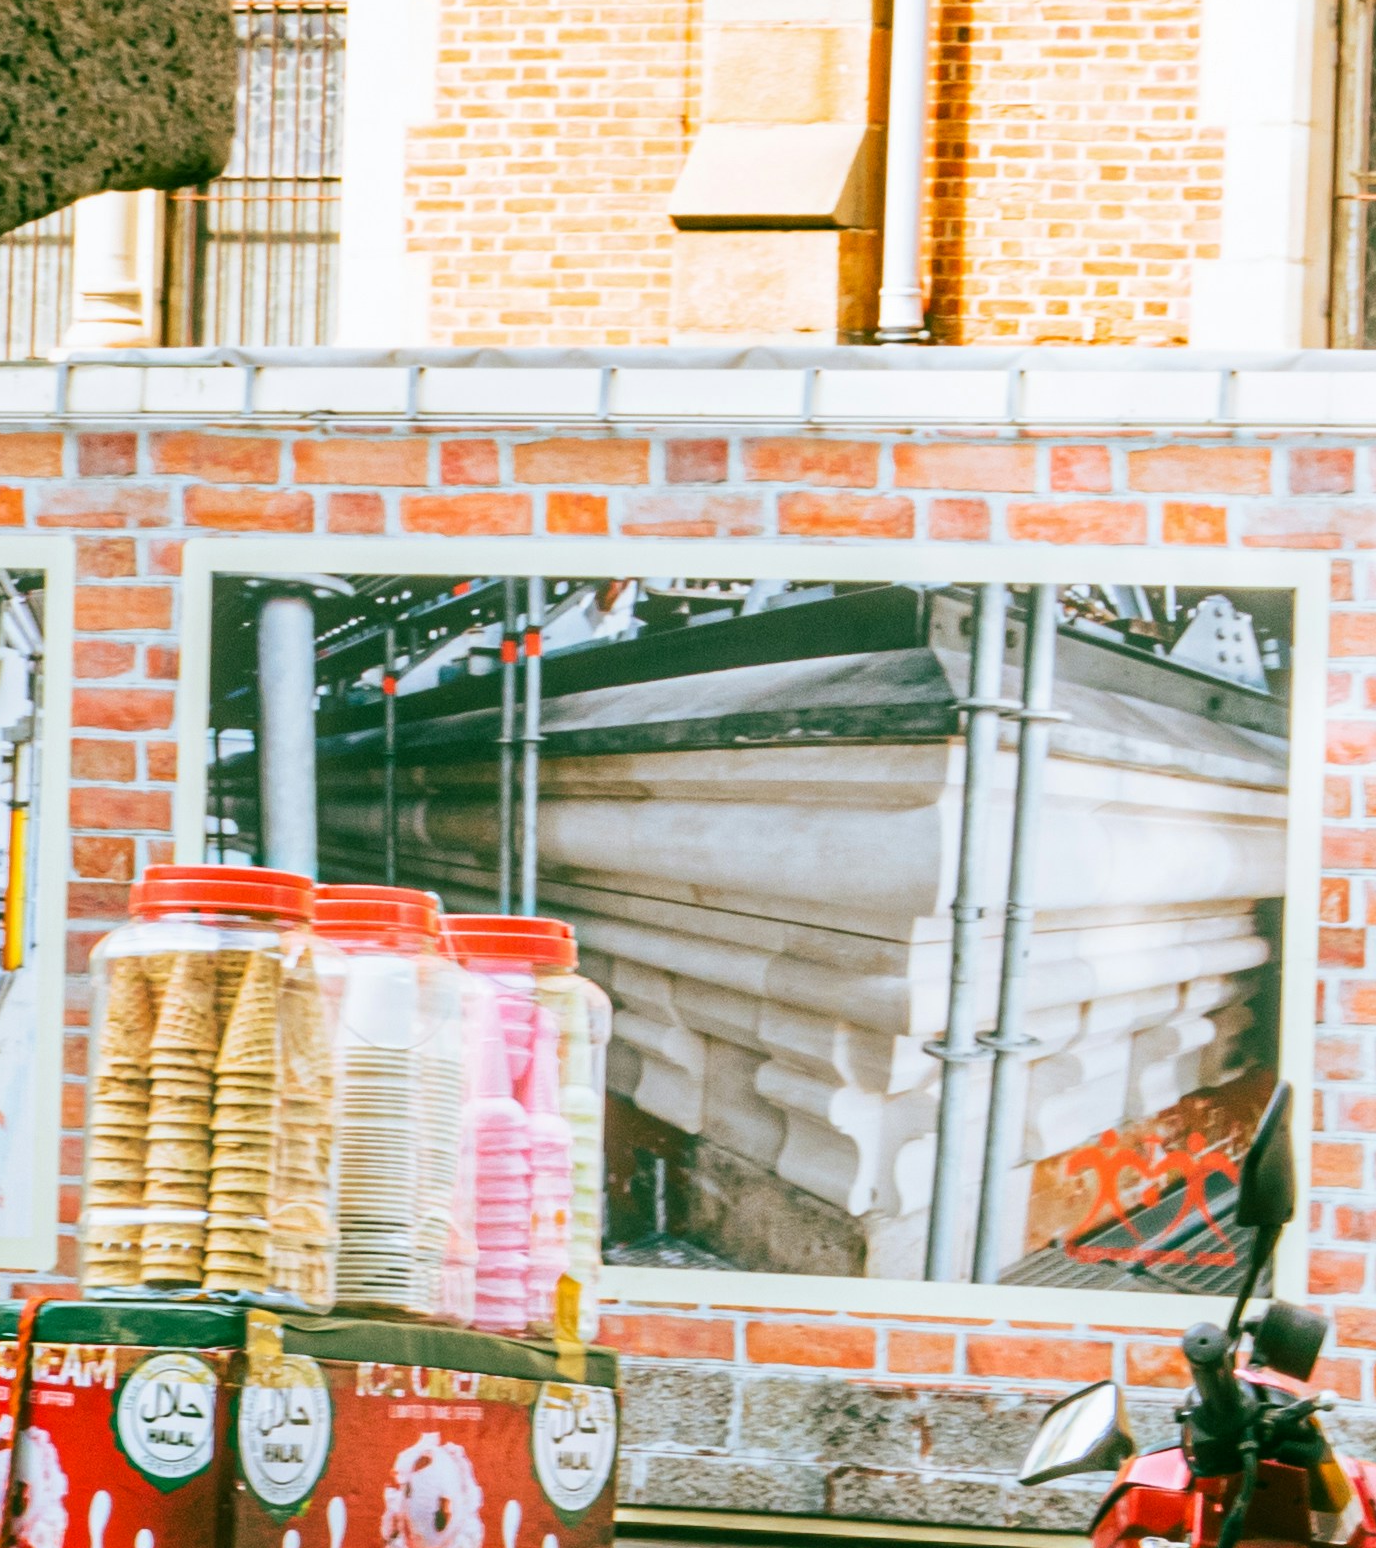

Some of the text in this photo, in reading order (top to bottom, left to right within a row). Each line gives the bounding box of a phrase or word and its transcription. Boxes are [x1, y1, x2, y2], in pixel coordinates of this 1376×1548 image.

[141, 1382, 205, 1423] حلال
[258, 1386, 312, 1437] حلال
[146, 1428, 195, 1448] HALAL
[263, 1443, 304, 1464] HALAL
[557, 1451, 593, 1471] HALAL
